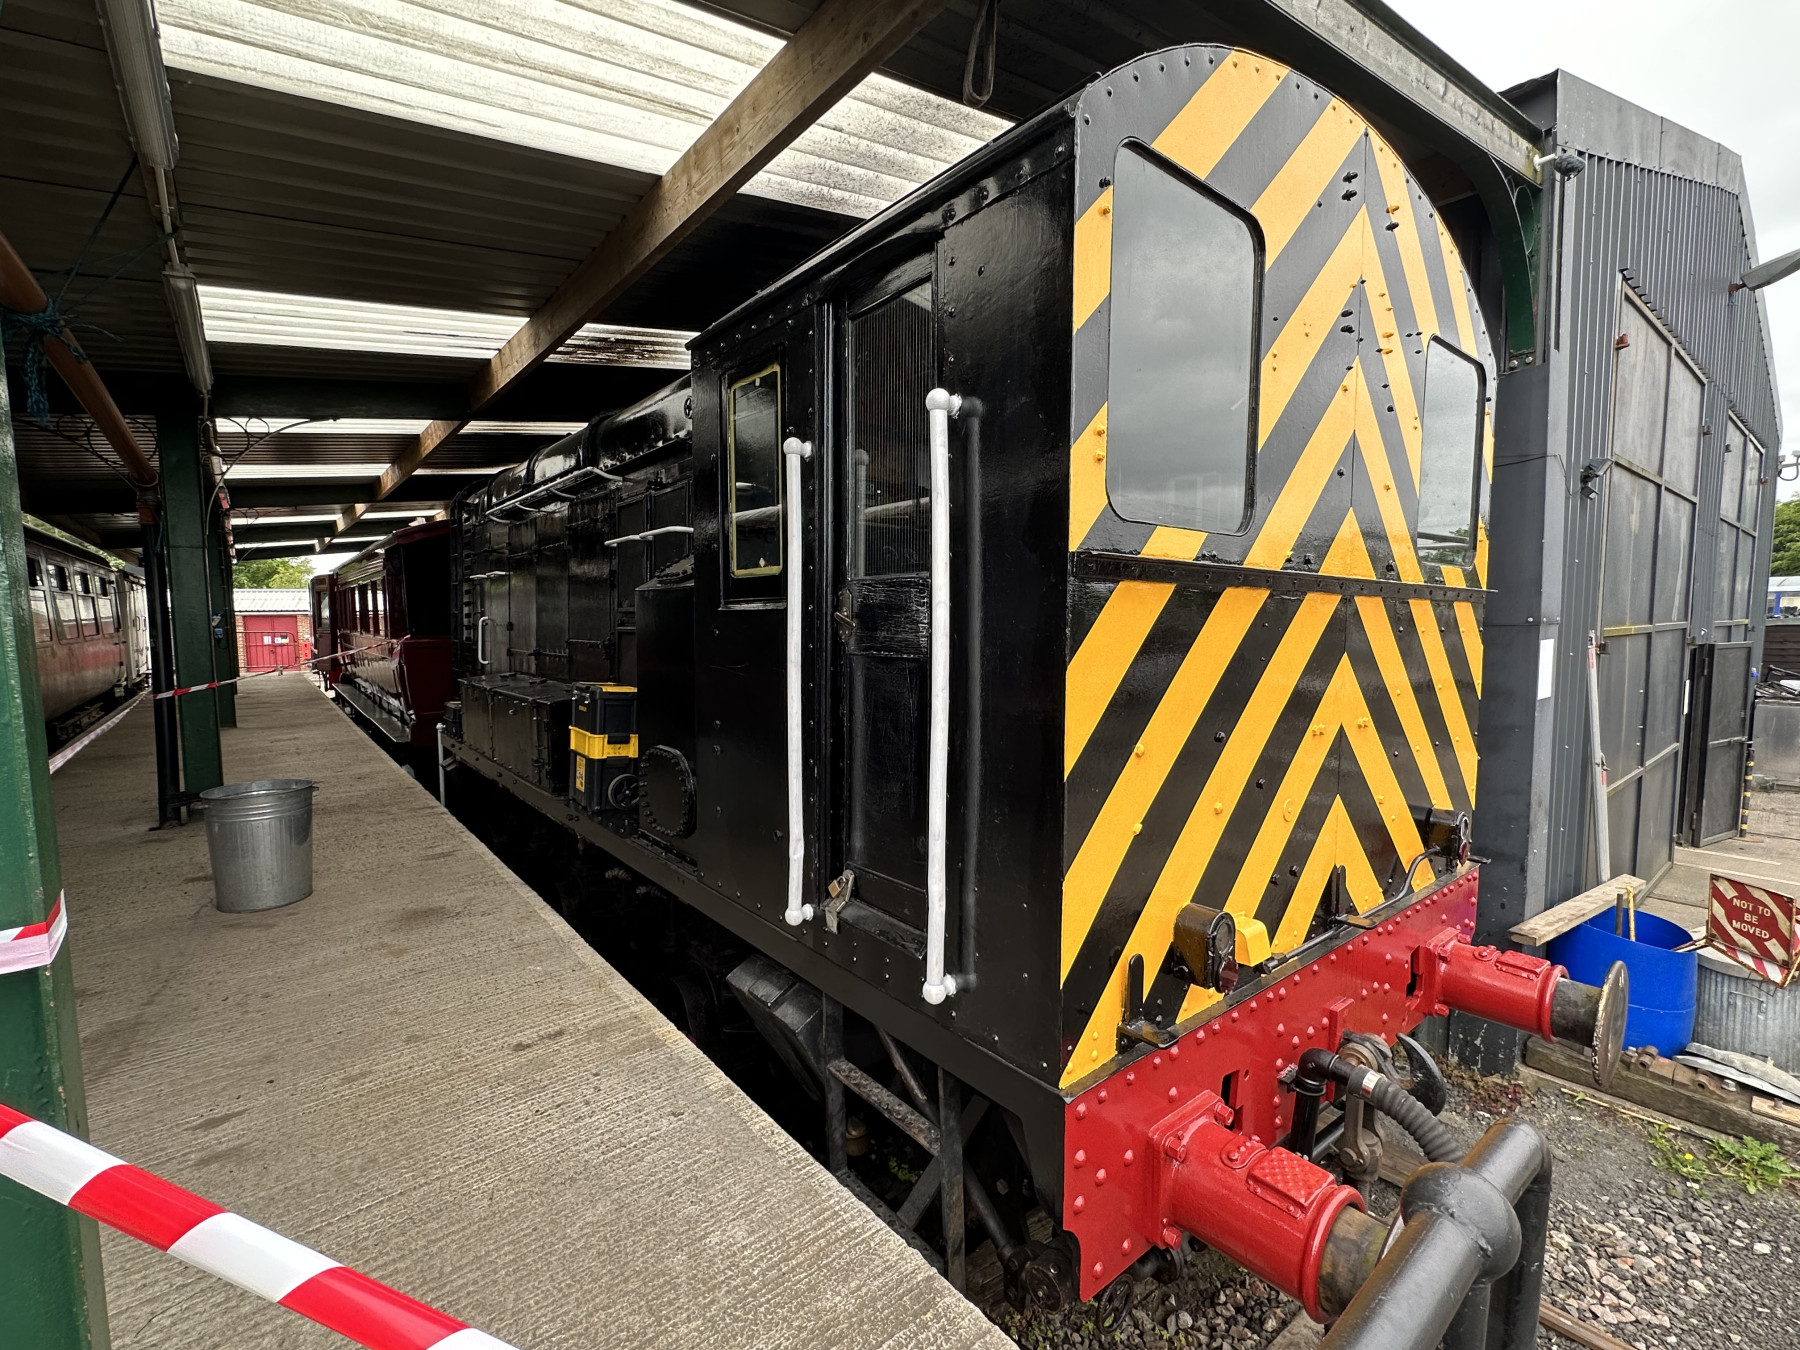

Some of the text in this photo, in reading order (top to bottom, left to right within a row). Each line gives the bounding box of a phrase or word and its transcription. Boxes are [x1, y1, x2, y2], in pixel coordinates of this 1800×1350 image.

[1733, 898, 1771, 917] NOT TO
[1744, 912, 1759, 925] BE
[1732, 920, 1770, 939] MOVED
